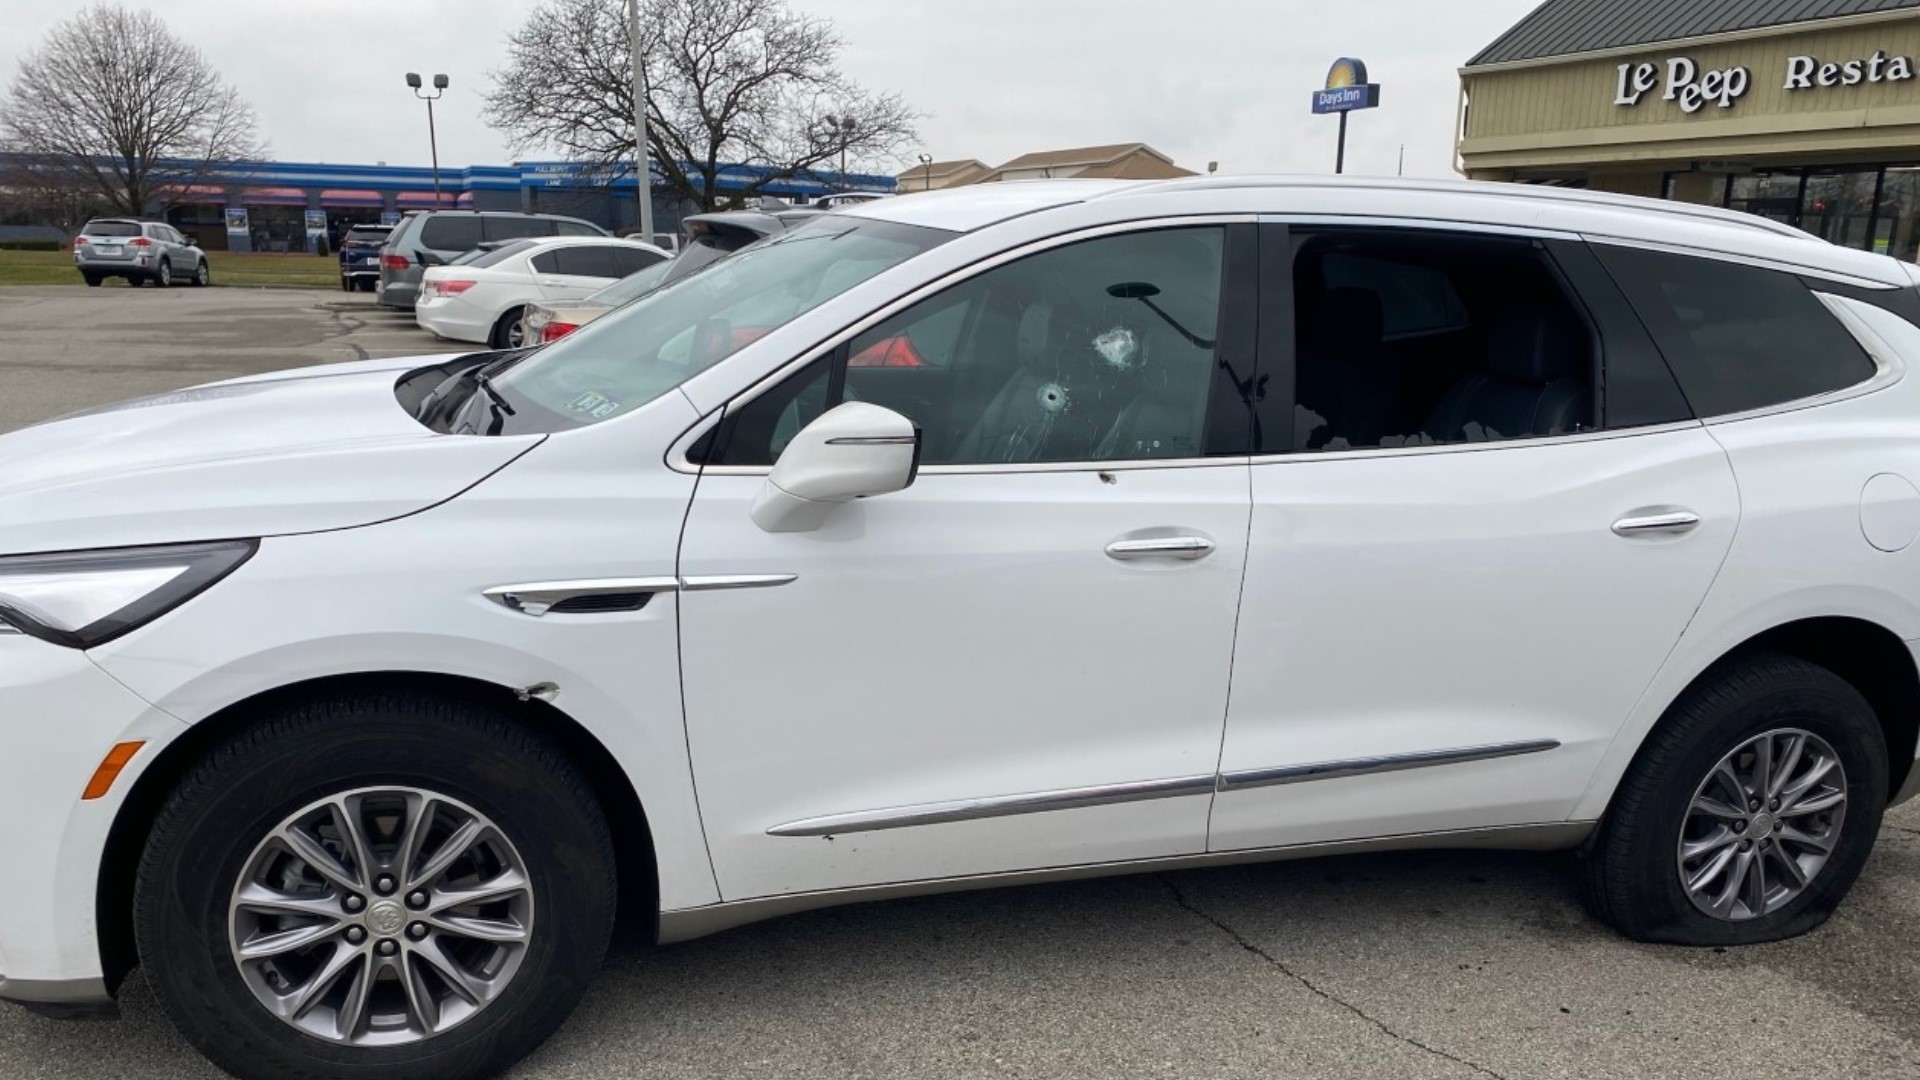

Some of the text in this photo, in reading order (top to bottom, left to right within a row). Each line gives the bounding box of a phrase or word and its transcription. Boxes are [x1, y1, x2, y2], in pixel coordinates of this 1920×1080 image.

[1319, 89, 1361, 106] Days Inn
[1613, 63, 1655, 105] Le
[1662, 57, 1747, 113] Peep
